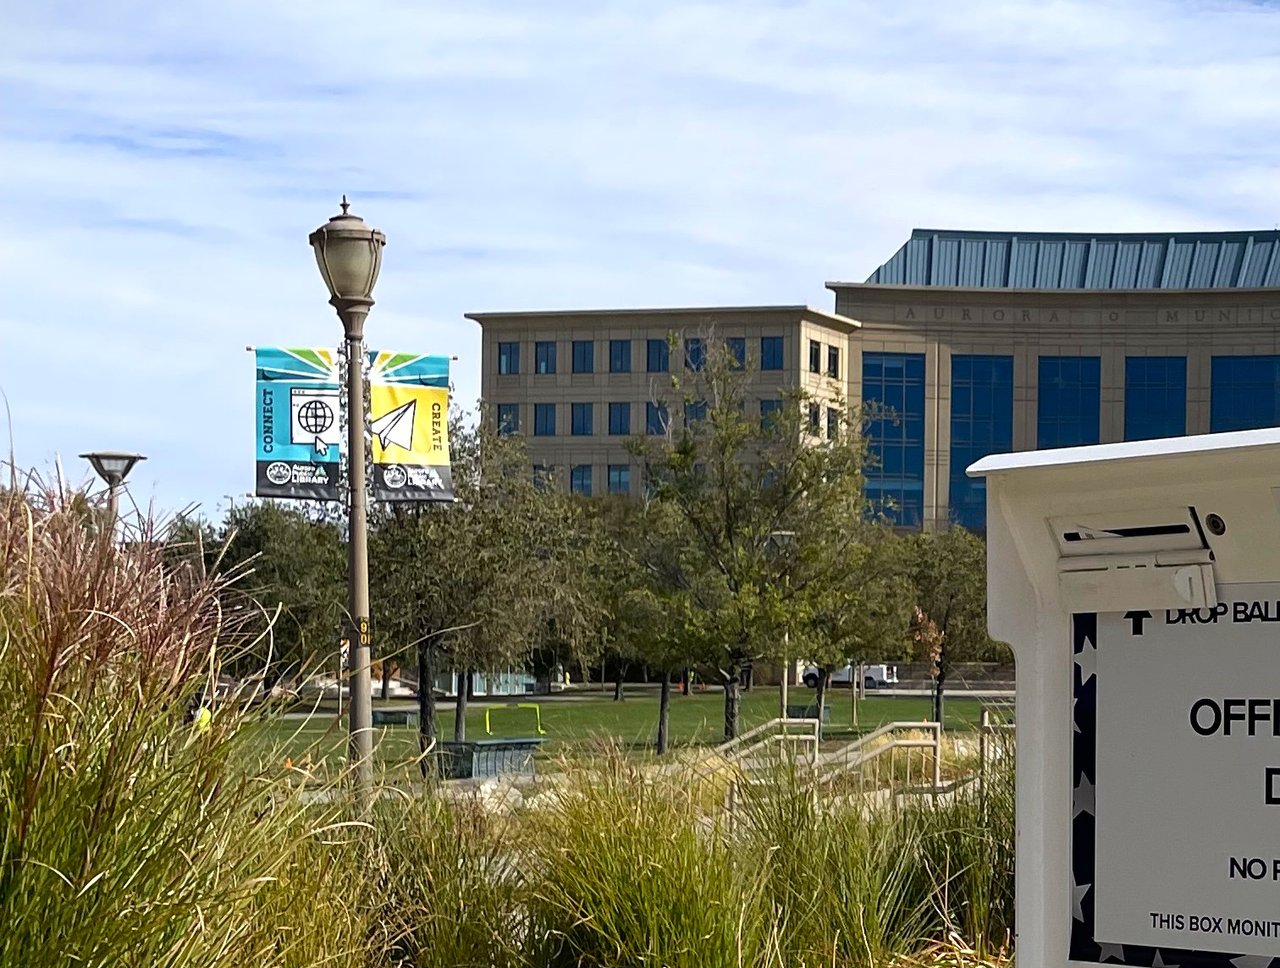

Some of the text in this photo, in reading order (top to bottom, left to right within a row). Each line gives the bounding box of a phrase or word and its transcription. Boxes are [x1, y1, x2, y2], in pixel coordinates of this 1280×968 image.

[905, 307, 1061, 323] AURORA
[263, 389, 273, 454] CONNECT
[431, 402, 442, 451] CREATE
[1165, 603, 1228, 624] DROP
[1229, 857, 1267, 880] NO
[1149, 912, 1185, 931] THIS
[1189, 916, 1223, 934] BOX
